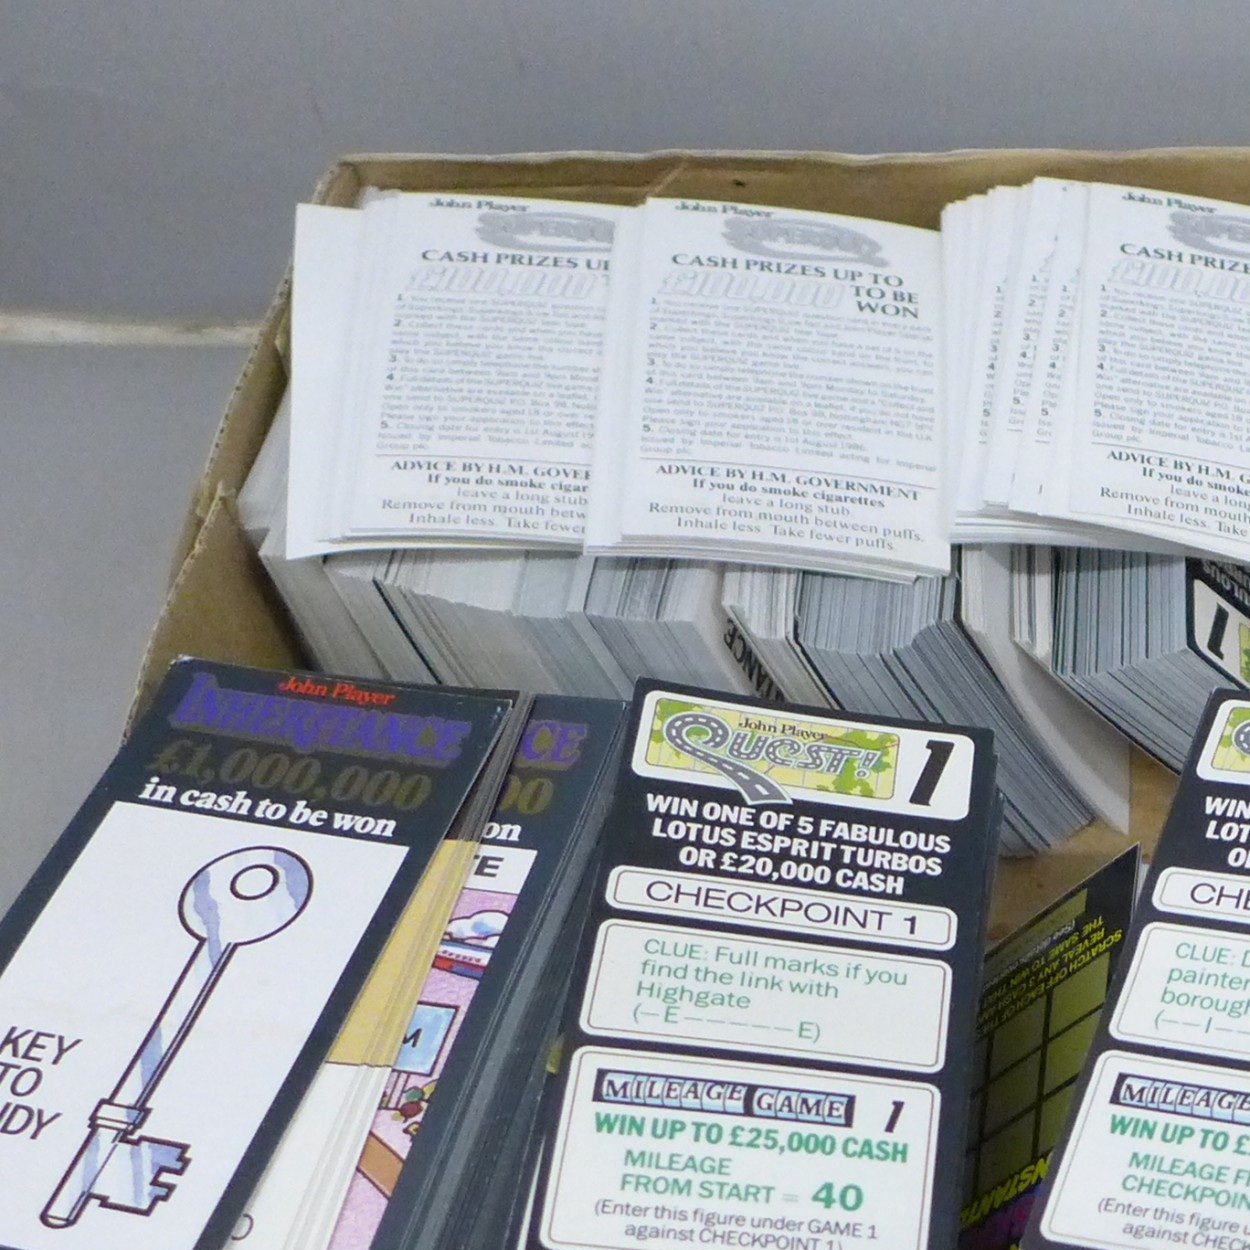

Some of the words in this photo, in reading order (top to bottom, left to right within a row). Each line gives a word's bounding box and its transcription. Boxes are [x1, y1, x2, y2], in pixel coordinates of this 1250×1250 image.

[674, 202, 717, 213] John
[721, 204, 773, 218] Player
[672, 253, 738, 269] CASH
[745, 259, 826, 278] PRIZES
[833, 268, 862, 282] UP
[869, 273, 904, 288] TO
[1120, 243, 1183, 262] CASH
[852, 285, 886, 300] TO
[893, 291, 919, 304] BE
[857, 301, 919, 319] WON
[656, 464, 720, 478] ADVICE
[726, 468, 748, 479] BY
[796, 476, 920, 501] GOVERNMENT
[649, 501, 711, 515] Remove
[716, 506, 752, 520] from
[759, 510, 809, 526] mouth
[814, 516, 878, 534] between
[278, 676, 328, 699] John
[332, 681, 396, 706] Player
[738, 717, 776, 733] John
[780, 724, 828, 742] Player
[909, 740, 955, 807] 1
[138, 777, 176, 802] in
[180, 784, 252, 816] cash
[255, 797, 288, 821] to
[290, 802, 328, 827] be
[334, 810, 397, 838] won
[647, 793, 698, 819] WIN
[702, 802, 755, 826] ONE
[761, 810, 793, 830] OF
[798, 816, 813, 834] 5
[820, 820, 951, 853] FABULOUS
[652, 818, 736, 845] LOTUS
[741, 831, 837, 860] ESPRIT
[841, 845, 942, 875] TURBOS
[679, 846, 717, 868] OR
[720, 851, 831, 880] £20,000
[836, 869, 904, 895] CASH
[646, 881, 892, 930] CHECKPOINT
[904, 915, 917, 935] 1
[644, 939, 708, 963] CLUE:
[715, 946, 758, 967] Full
[764, 955, 839, 977] marks
[845, 963, 863, 980] if
[866, 970, 907, 985] you
[1175, 942, 1235, 966] CLUE:
[636, 981, 751, 1009] Highgate
[2, 1028, 81, 1065] KEY
[603, 1077, 747, 1103] MILEAGE
[756, 1090, 845, 1119] GAME
[885, 1101, 904, 1133] 1
[595, 1112, 646, 1137] WIN
[652, 1118, 686, 1141] UP
[691, 1122, 722, 1145] TO
[728, 1126, 836, 1156] £25,000
[841, 1137, 908, 1163] CASH
[812, 1182, 863, 1211] 40
